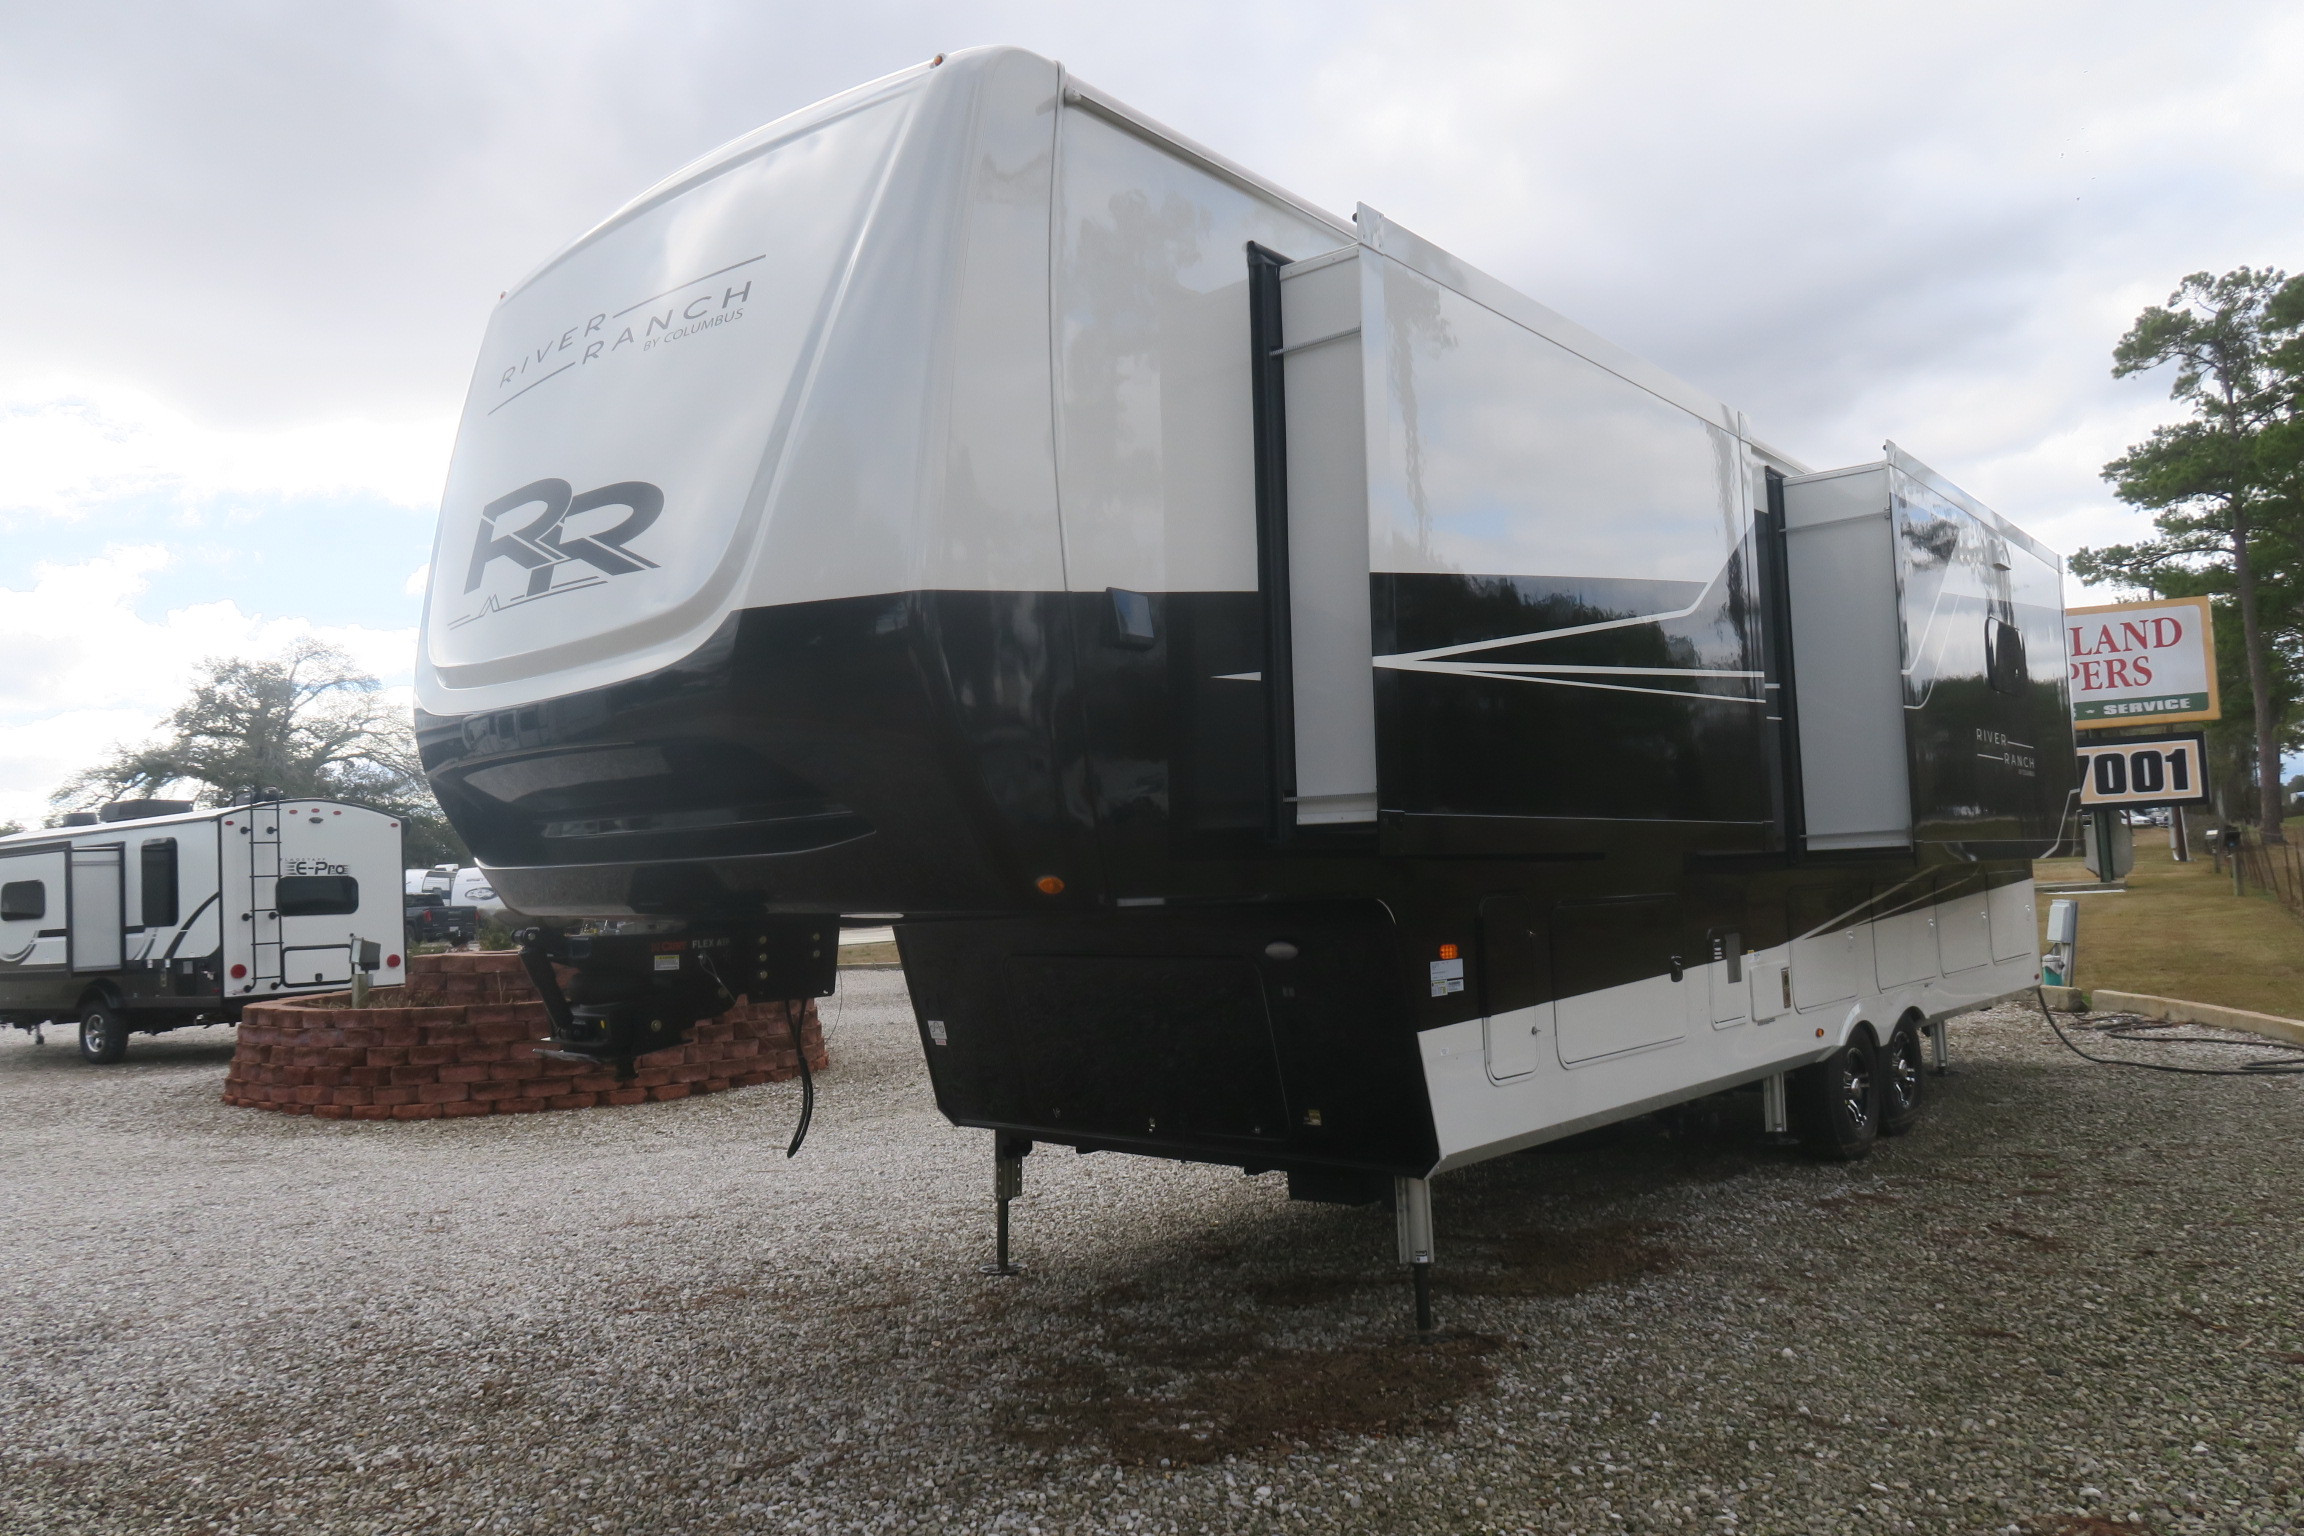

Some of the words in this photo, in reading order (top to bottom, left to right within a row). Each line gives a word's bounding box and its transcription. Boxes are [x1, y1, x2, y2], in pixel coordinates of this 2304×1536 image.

[582, 280, 752, 365] RANCH
[643, 337, 661, 352] BY
[664, 307, 745, 344] COLUMBUS
[499, 312, 607, 389] RIVER
[2069, 617, 2183, 657] LAND
[2103, 698, 2191, 715] SERVICE
[1976, 728, 2007, 746] RIVER
[2004, 752, 2035, 768] RANCH
[296, 861, 345, 876] E-Pro
[692, 938, 714, 949] FLEX
